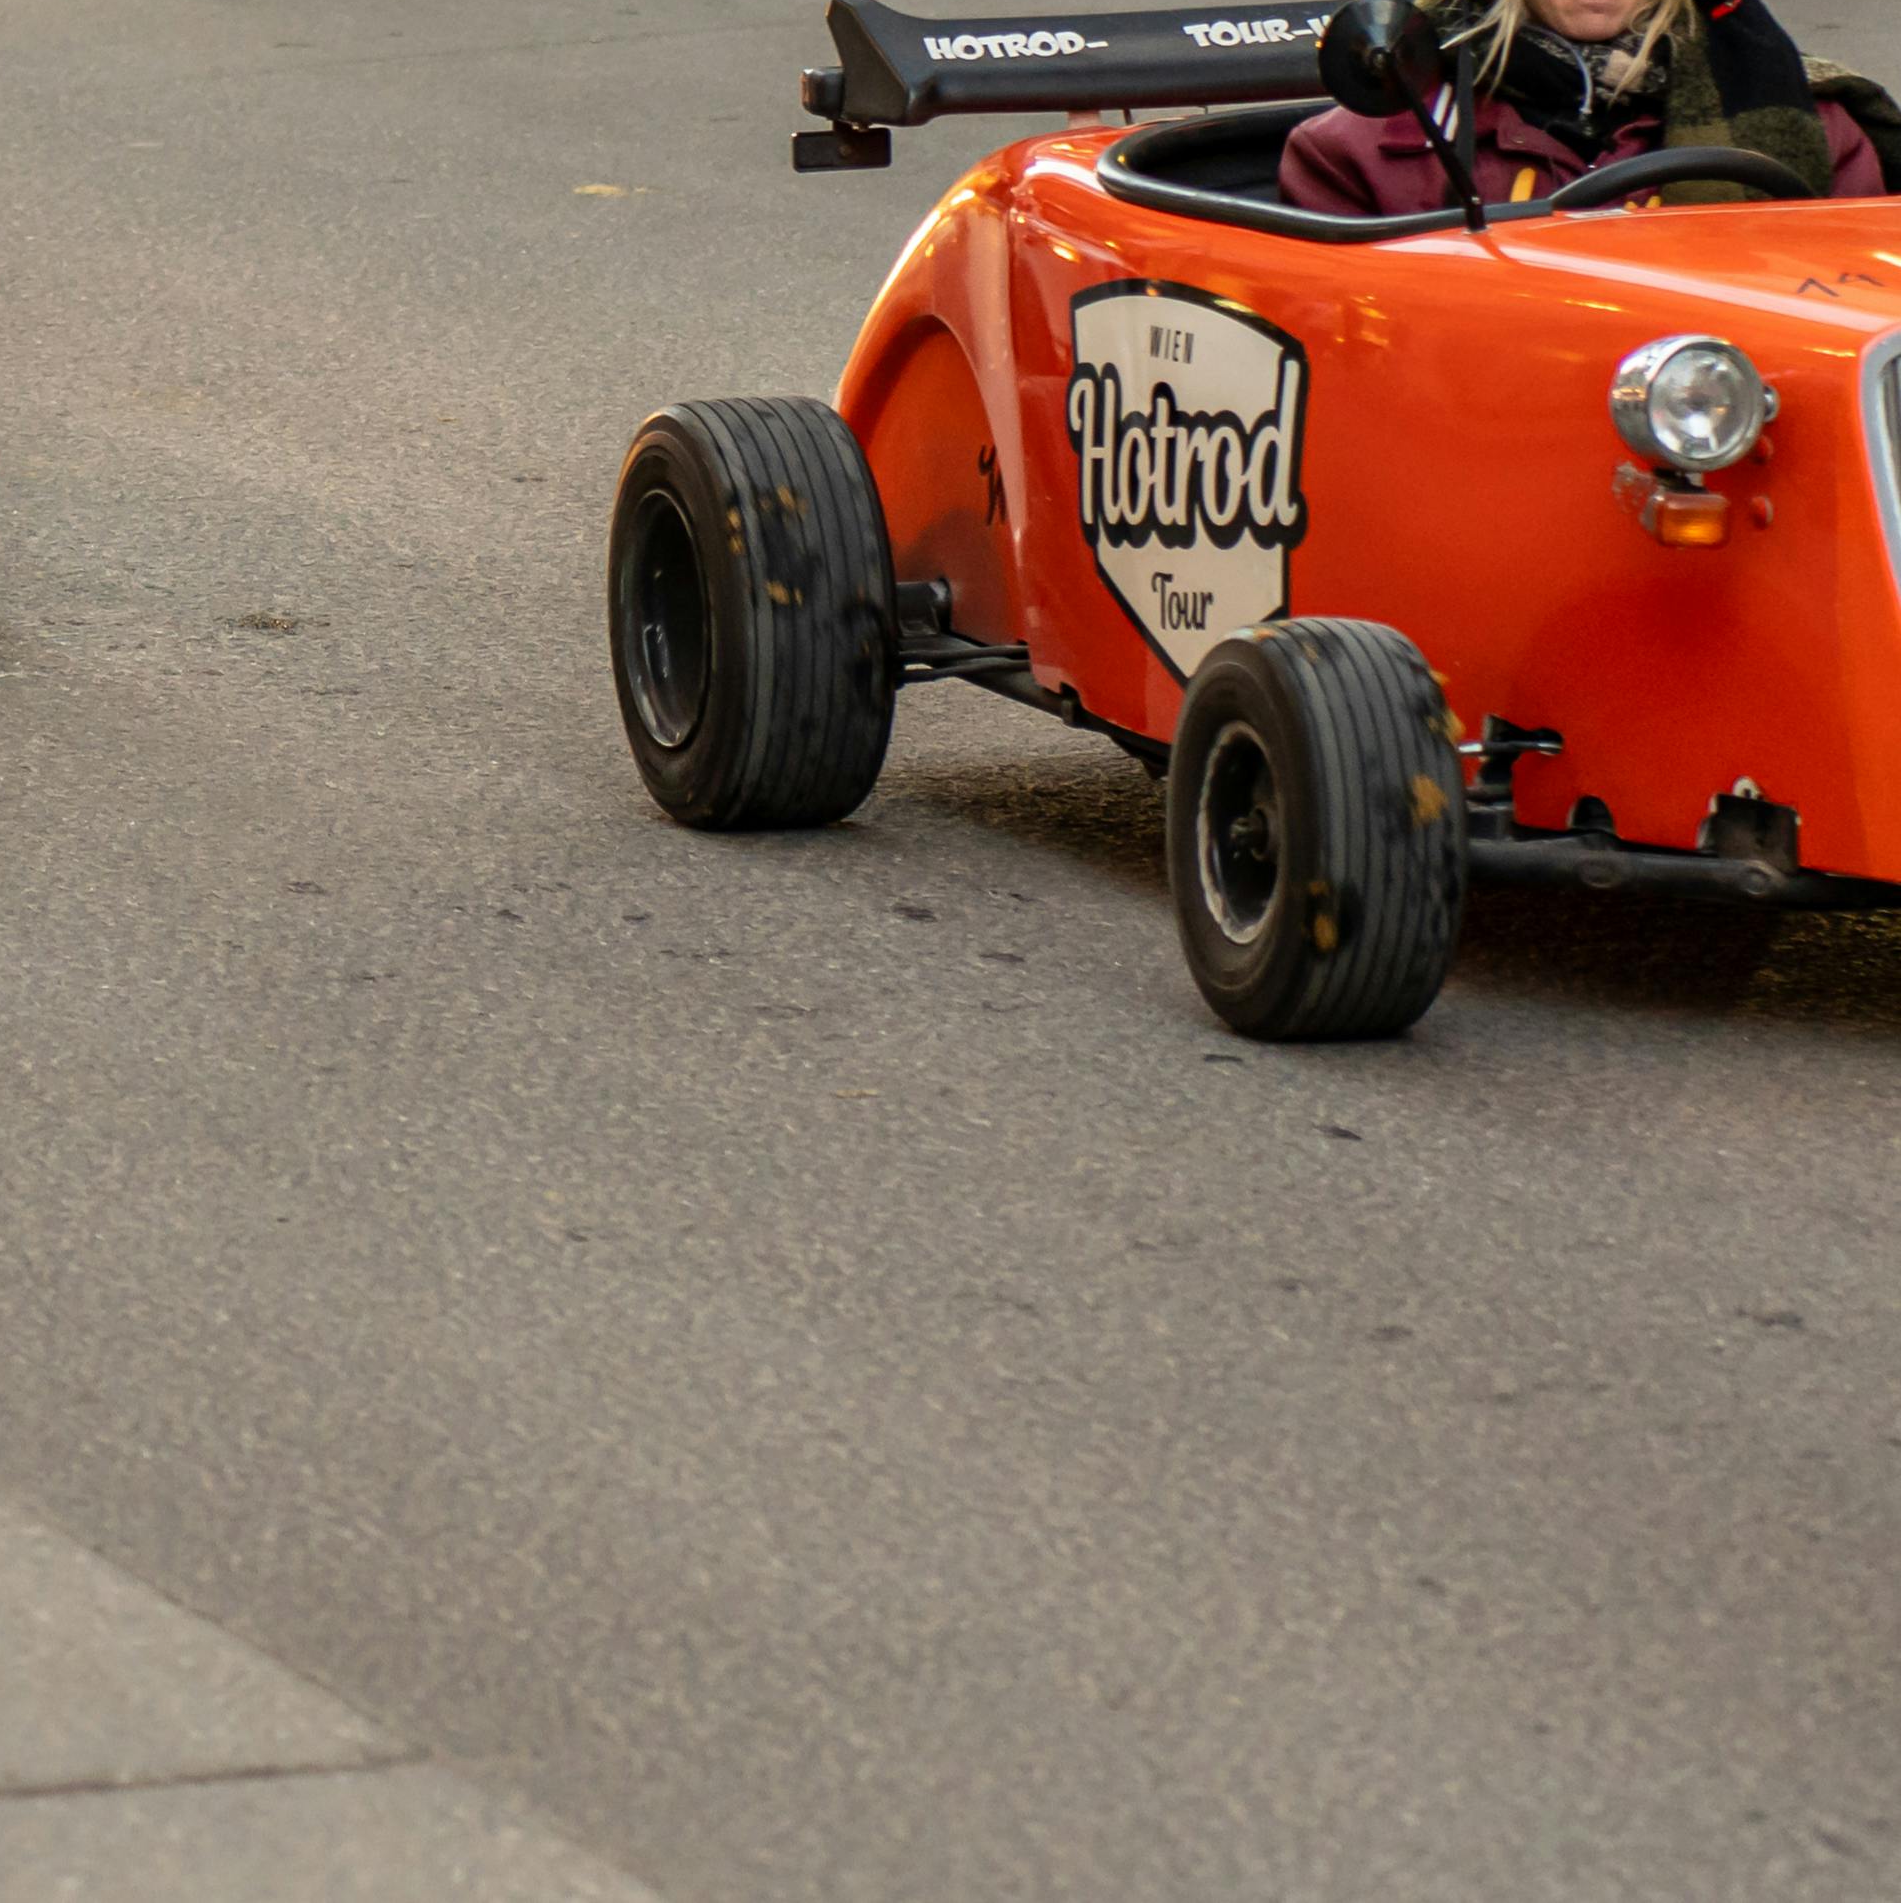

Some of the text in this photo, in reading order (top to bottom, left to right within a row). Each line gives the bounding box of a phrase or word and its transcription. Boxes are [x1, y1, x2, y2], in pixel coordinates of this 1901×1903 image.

[923, 31, 1109, 61] HOTROD-
[1149, 324, 1195, 364] WIEN
[1067, 360, 1305, 548] Hotrod
[1151, 572, 1214, 631] Tour
